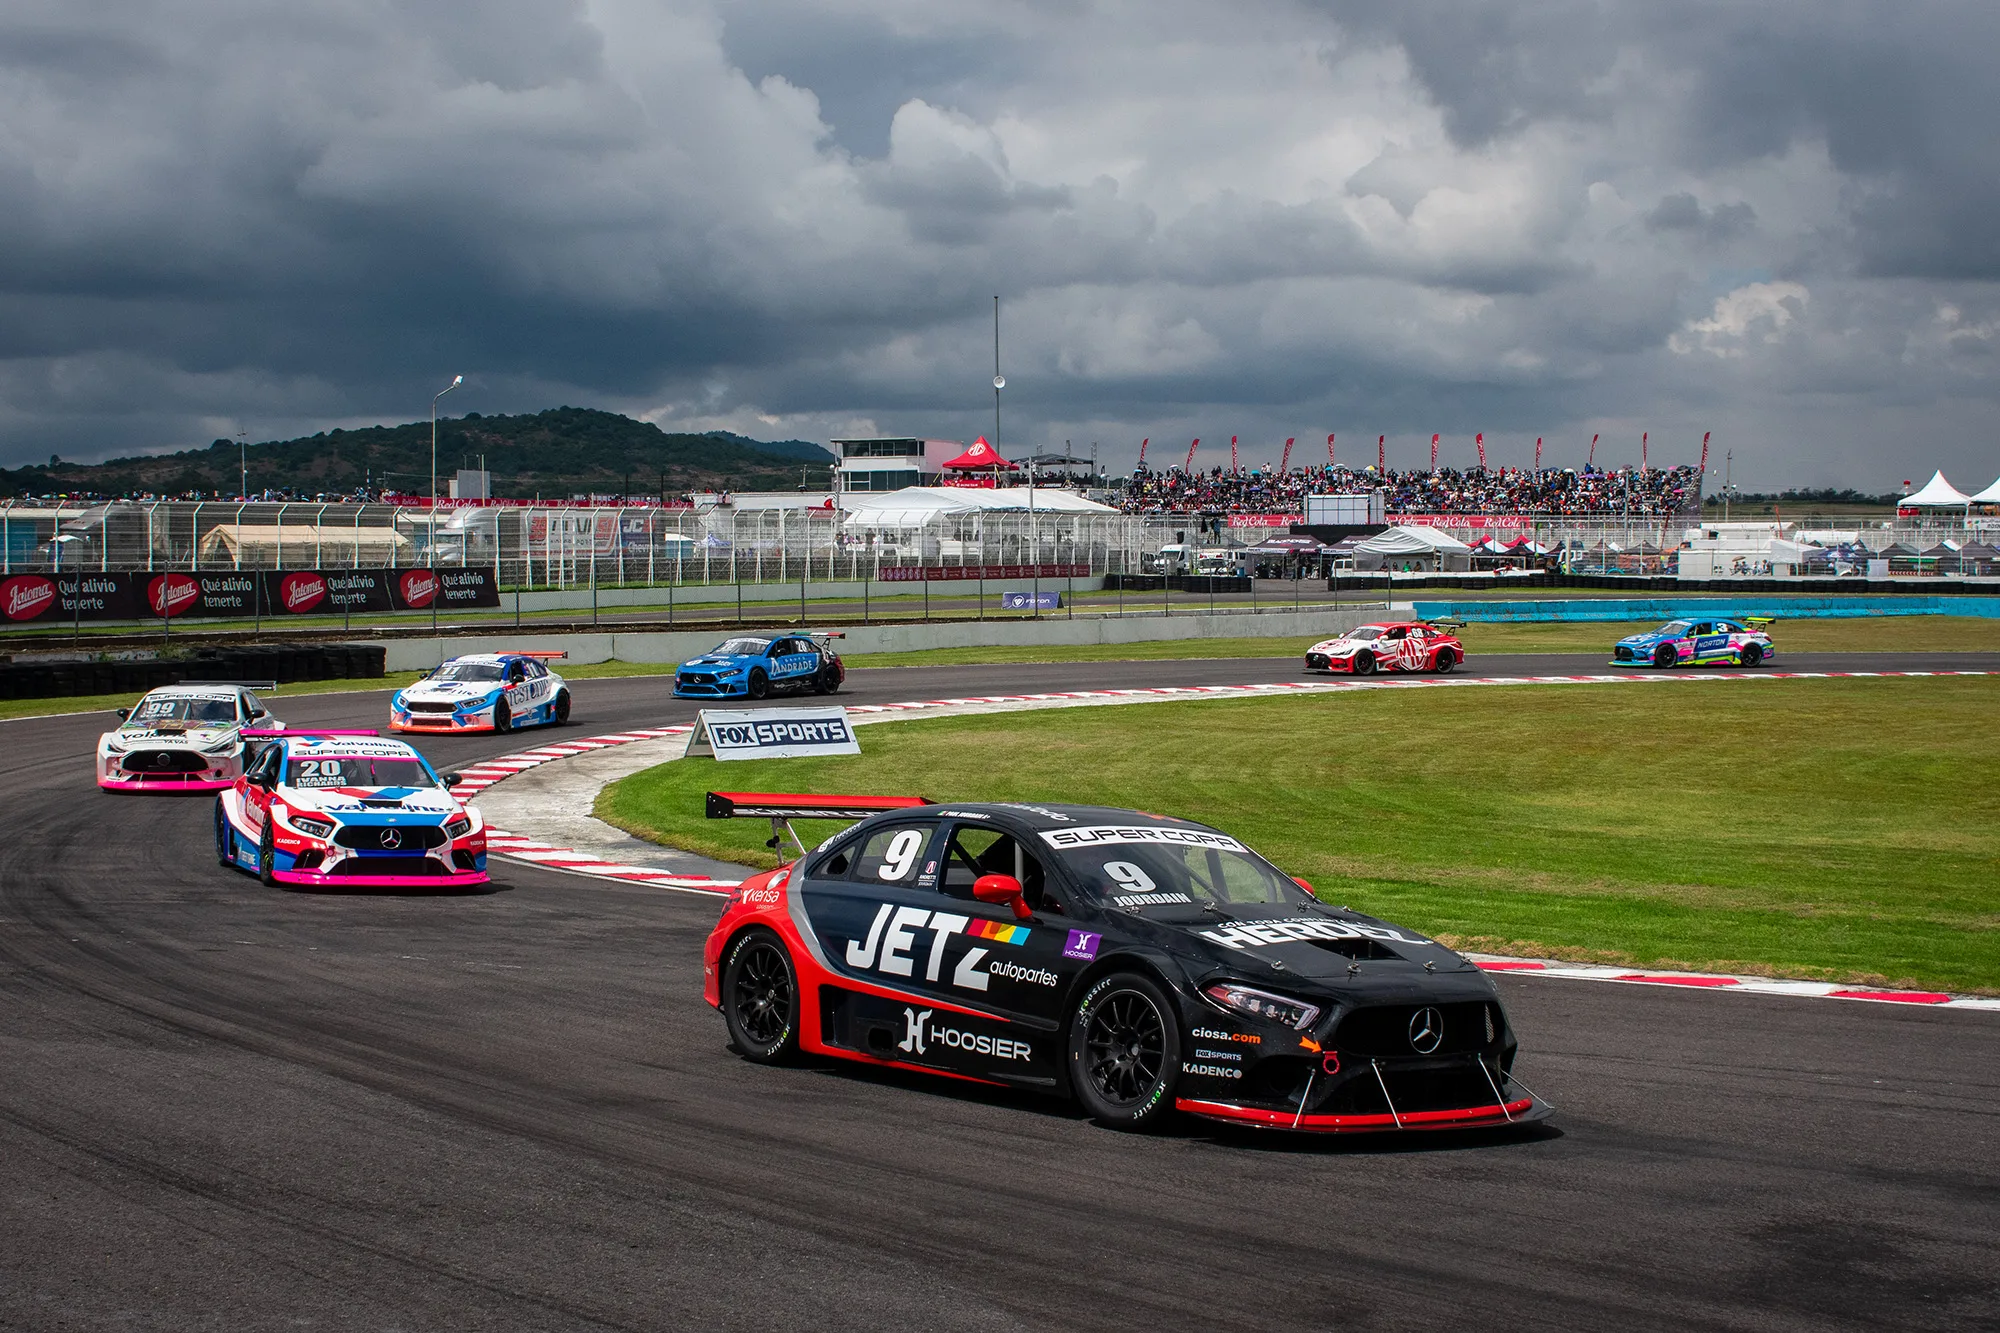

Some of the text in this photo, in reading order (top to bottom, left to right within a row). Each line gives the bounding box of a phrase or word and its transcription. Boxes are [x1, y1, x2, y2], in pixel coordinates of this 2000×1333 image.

[968, 443, 985, 456] MG
[59, 578, 117, 594] Qué alivio
[201, 576, 253, 593] Qué alivio
[327, 574, 375, 591] Qué alivio
[441, 572, 484, 588] Qué alivio
[8, 582, 53, 614] Jaloma
[204, 594, 242, 608] tenerte
[287, 579, 324, 608] Jaloma
[331, 592, 367, 605] tenerte
[444, 588, 477, 600] tenerte
[62, 598, 105, 610] tenerte
[1411, 627, 1424, 639] 68
[1717, 622, 1729, 633] 3
[796, 639, 807, 653] 28
[1698, 638, 1725, 649] NORTON
[441, 666, 461, 675] 11
[527, 661, 540, 678] 11
[149, 693, 233, 701] SUPER COPA
[146, 702, 175, 715] 99
[715, 722, 846, 745] FOX SPORTS
[330, 740, 401, 749] Valvoline
[294, 749, 411, 757] SUPER COPA
[300, 760, 341, 778] 20
[296, 775, 345, 783] IVANNA
[296, 780, 347, 788] RICHARDS
[1053, 828, 1239, 849] SUPER COPA
[877, 829, 923, 881] 9
[1102, 861, 1157, 893] 9
[749, 888, 780, 904] kensa
[1113, 892, 1192, 908] JOURDAIN
[1217, 920, 1238, 930] CON
[1246, 918, 1281, 929] TODA
[1200, 921, 1435, 949] HERDEZ
[1065, 949, 1093, 960] HOOSIER
[990, 960, 1058, 988] autopartes
[930, 1024, 1032, 1062] HOOSIER
[1191, 1027, 1261, 1045] ciosa.com
[1196, 1049, 1242, 1061] FOX SPORTS
[1182, 1061, 1243, 1079] KADENCO
